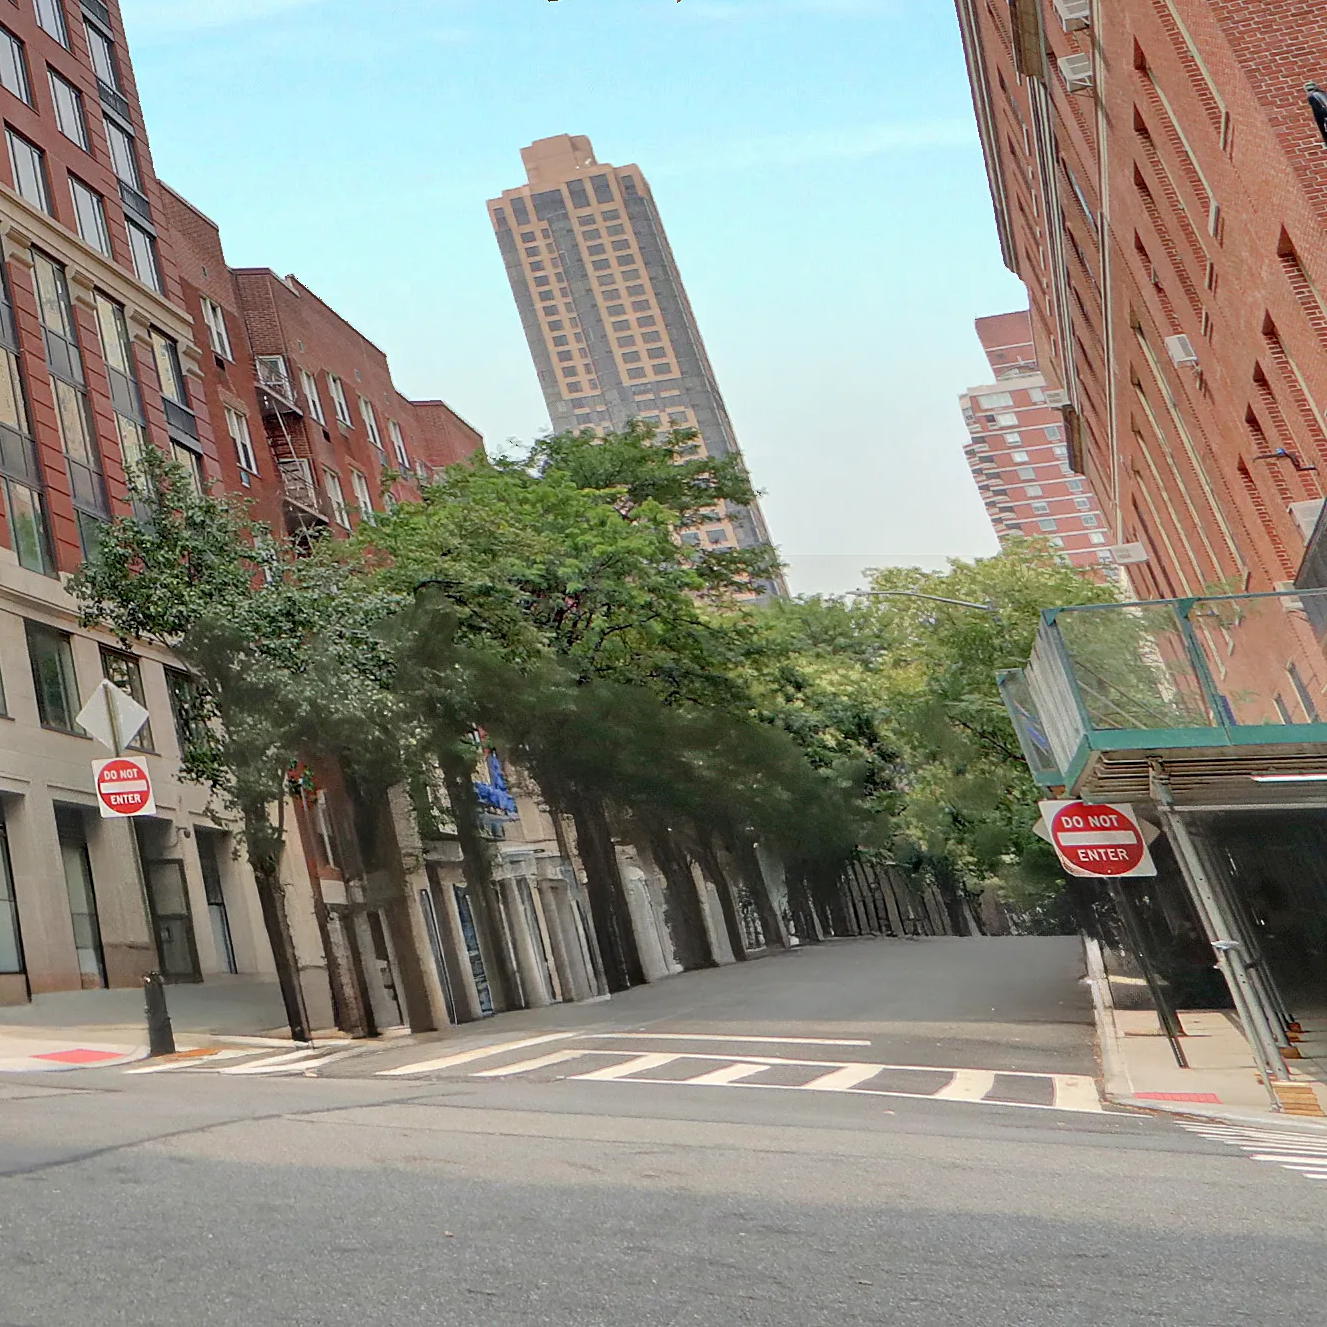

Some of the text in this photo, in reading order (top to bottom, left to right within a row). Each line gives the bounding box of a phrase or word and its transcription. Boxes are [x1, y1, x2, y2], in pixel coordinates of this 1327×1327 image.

[104, 768, 138, 780] DO NOT
[110, 794, 142, 805] ENTER
[1061, 815, 1119, 828] DO NOT
[1077, 848, 1129, 861] ENTER
